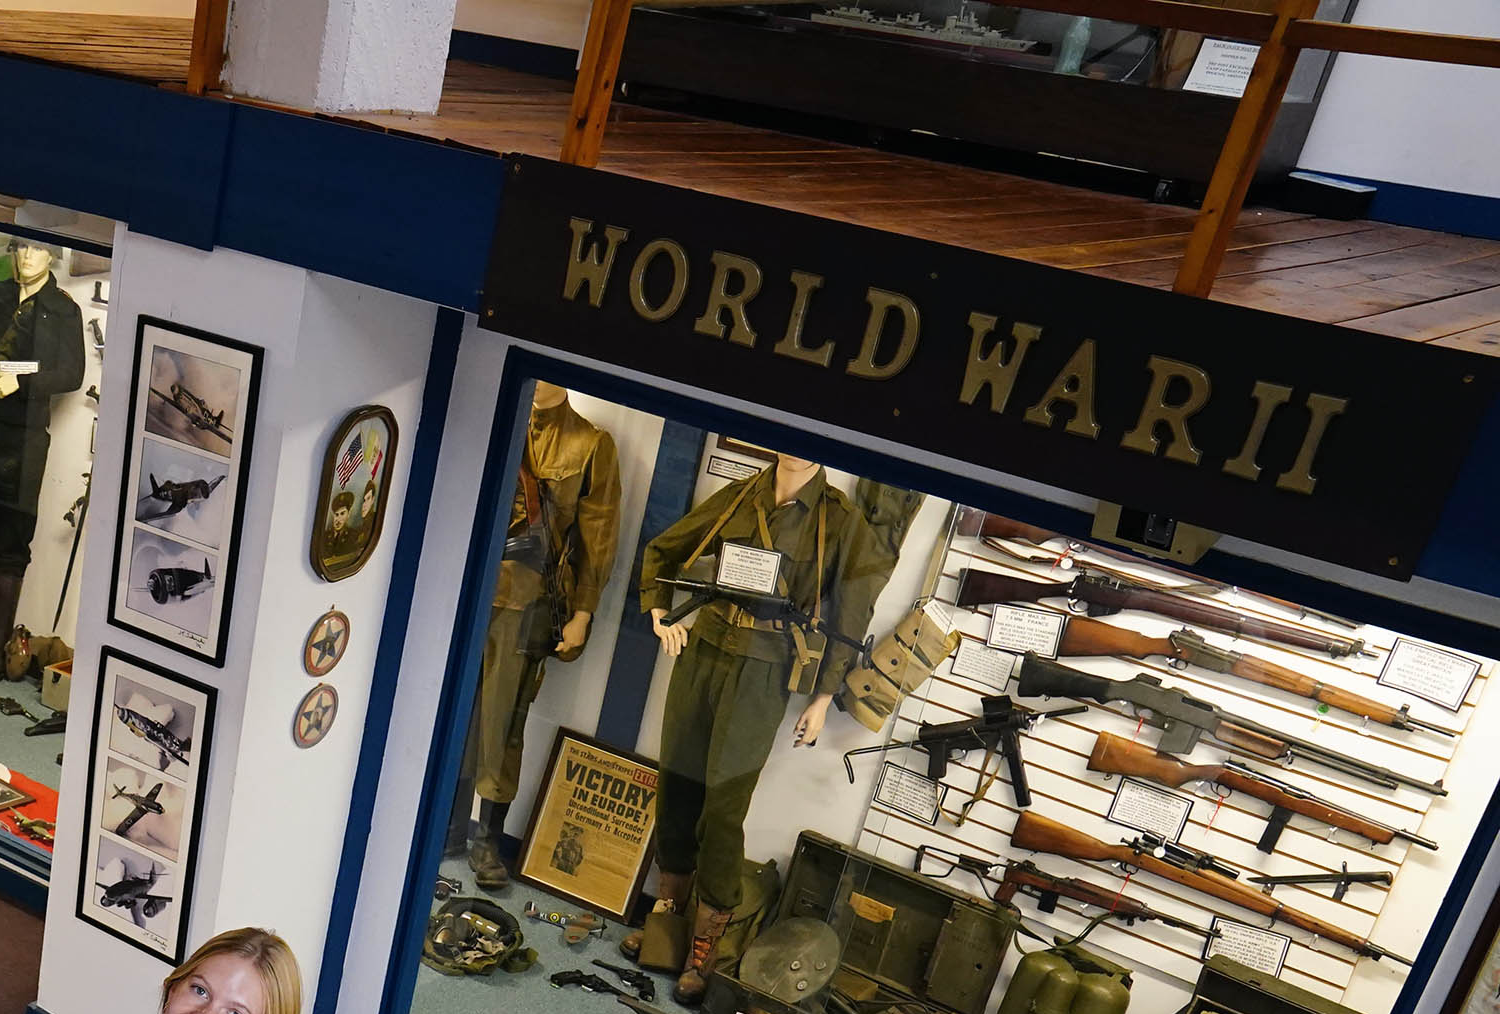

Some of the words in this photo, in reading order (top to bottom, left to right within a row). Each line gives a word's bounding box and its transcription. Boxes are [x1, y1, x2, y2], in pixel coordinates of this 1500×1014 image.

[561, 216, 921, 381] WORLD
[956, 311, 1212, 467] WAR
[1221, 379, 1348, 495] II
[580, 750, 597, 763] STARS
[611, 761, 635, 777] STRIPES
[566, 760, 655, 809] VICTORY
[572, 786, 588, 803] IN
[566, 808, 574, 817] Of
[575, 812, 603, 831] Germany
[613, 828, 642, 845] Accepted
[568, 801, 610, 822] Unconditional
[612, 816, 645, 836] Surrender
